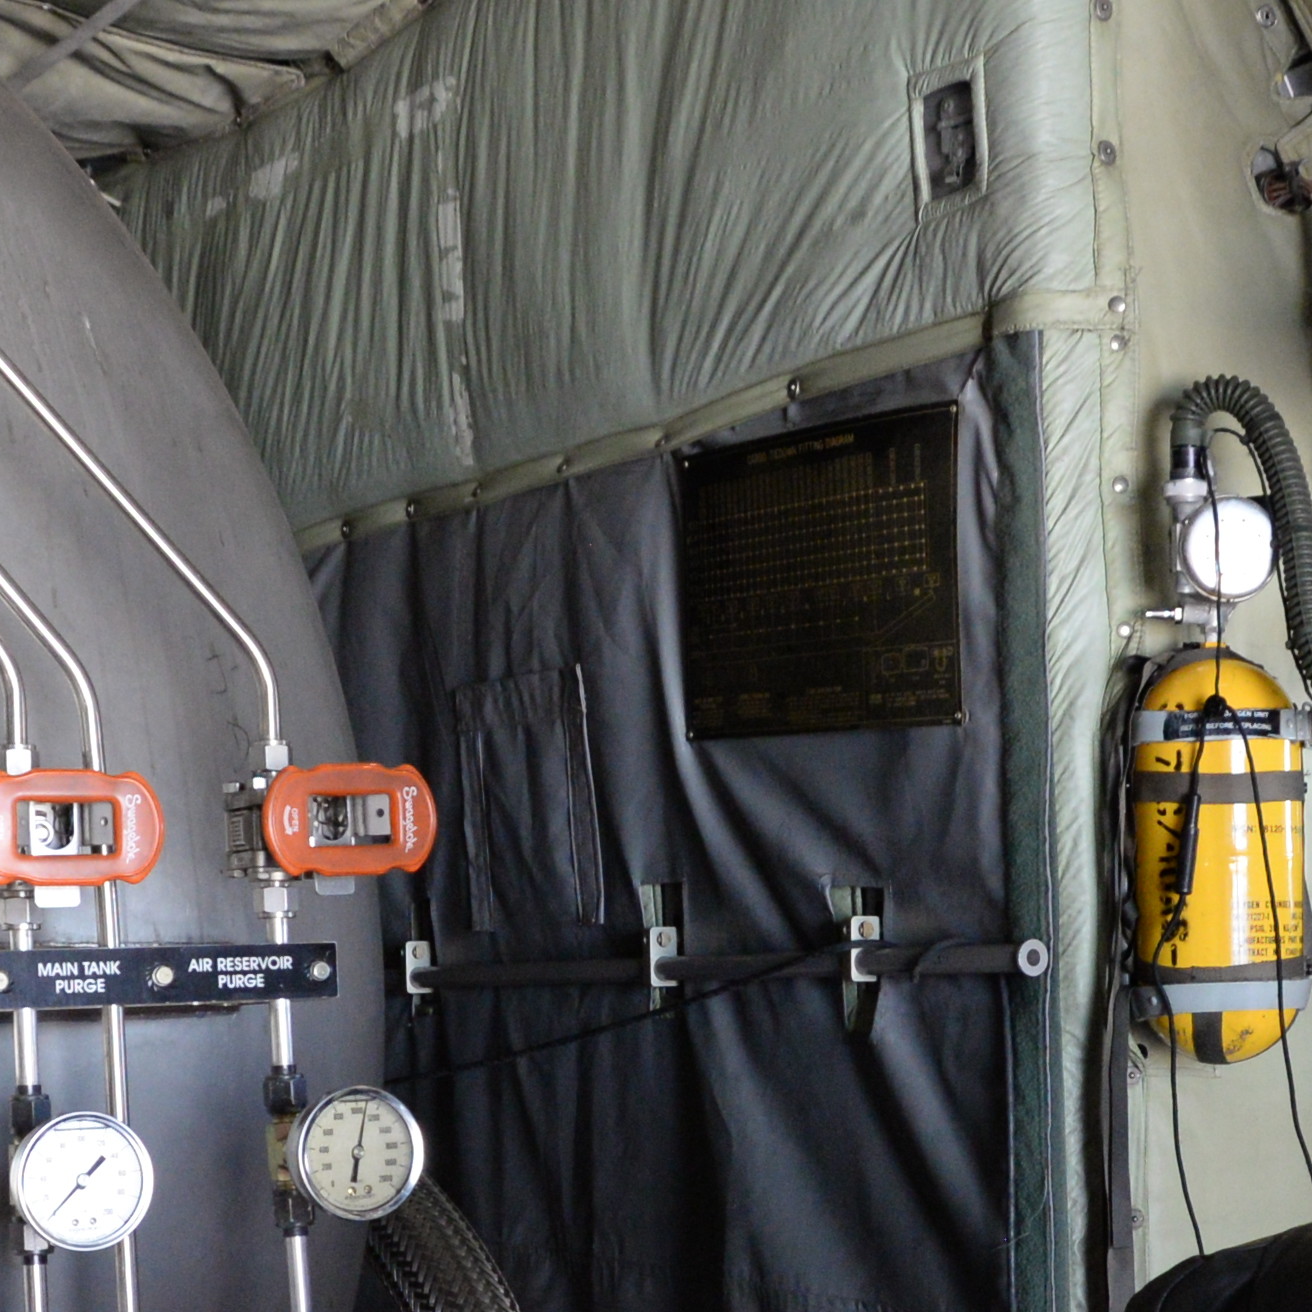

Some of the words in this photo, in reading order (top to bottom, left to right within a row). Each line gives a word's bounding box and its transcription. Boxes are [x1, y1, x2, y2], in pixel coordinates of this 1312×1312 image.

[403, 786, 417, 853] Swagelok
[125, 794, 141, 864] Swagelok
[38, 962, 79, 978] MAIN
[82, 960, 121, 976] TANK
[188, 957, 213, 973] AIR
[217, 956, 293, 972] RESERVOIR
[55, 979, 106, 994] PURGE
[218, 973, 265, 989] PURGE
